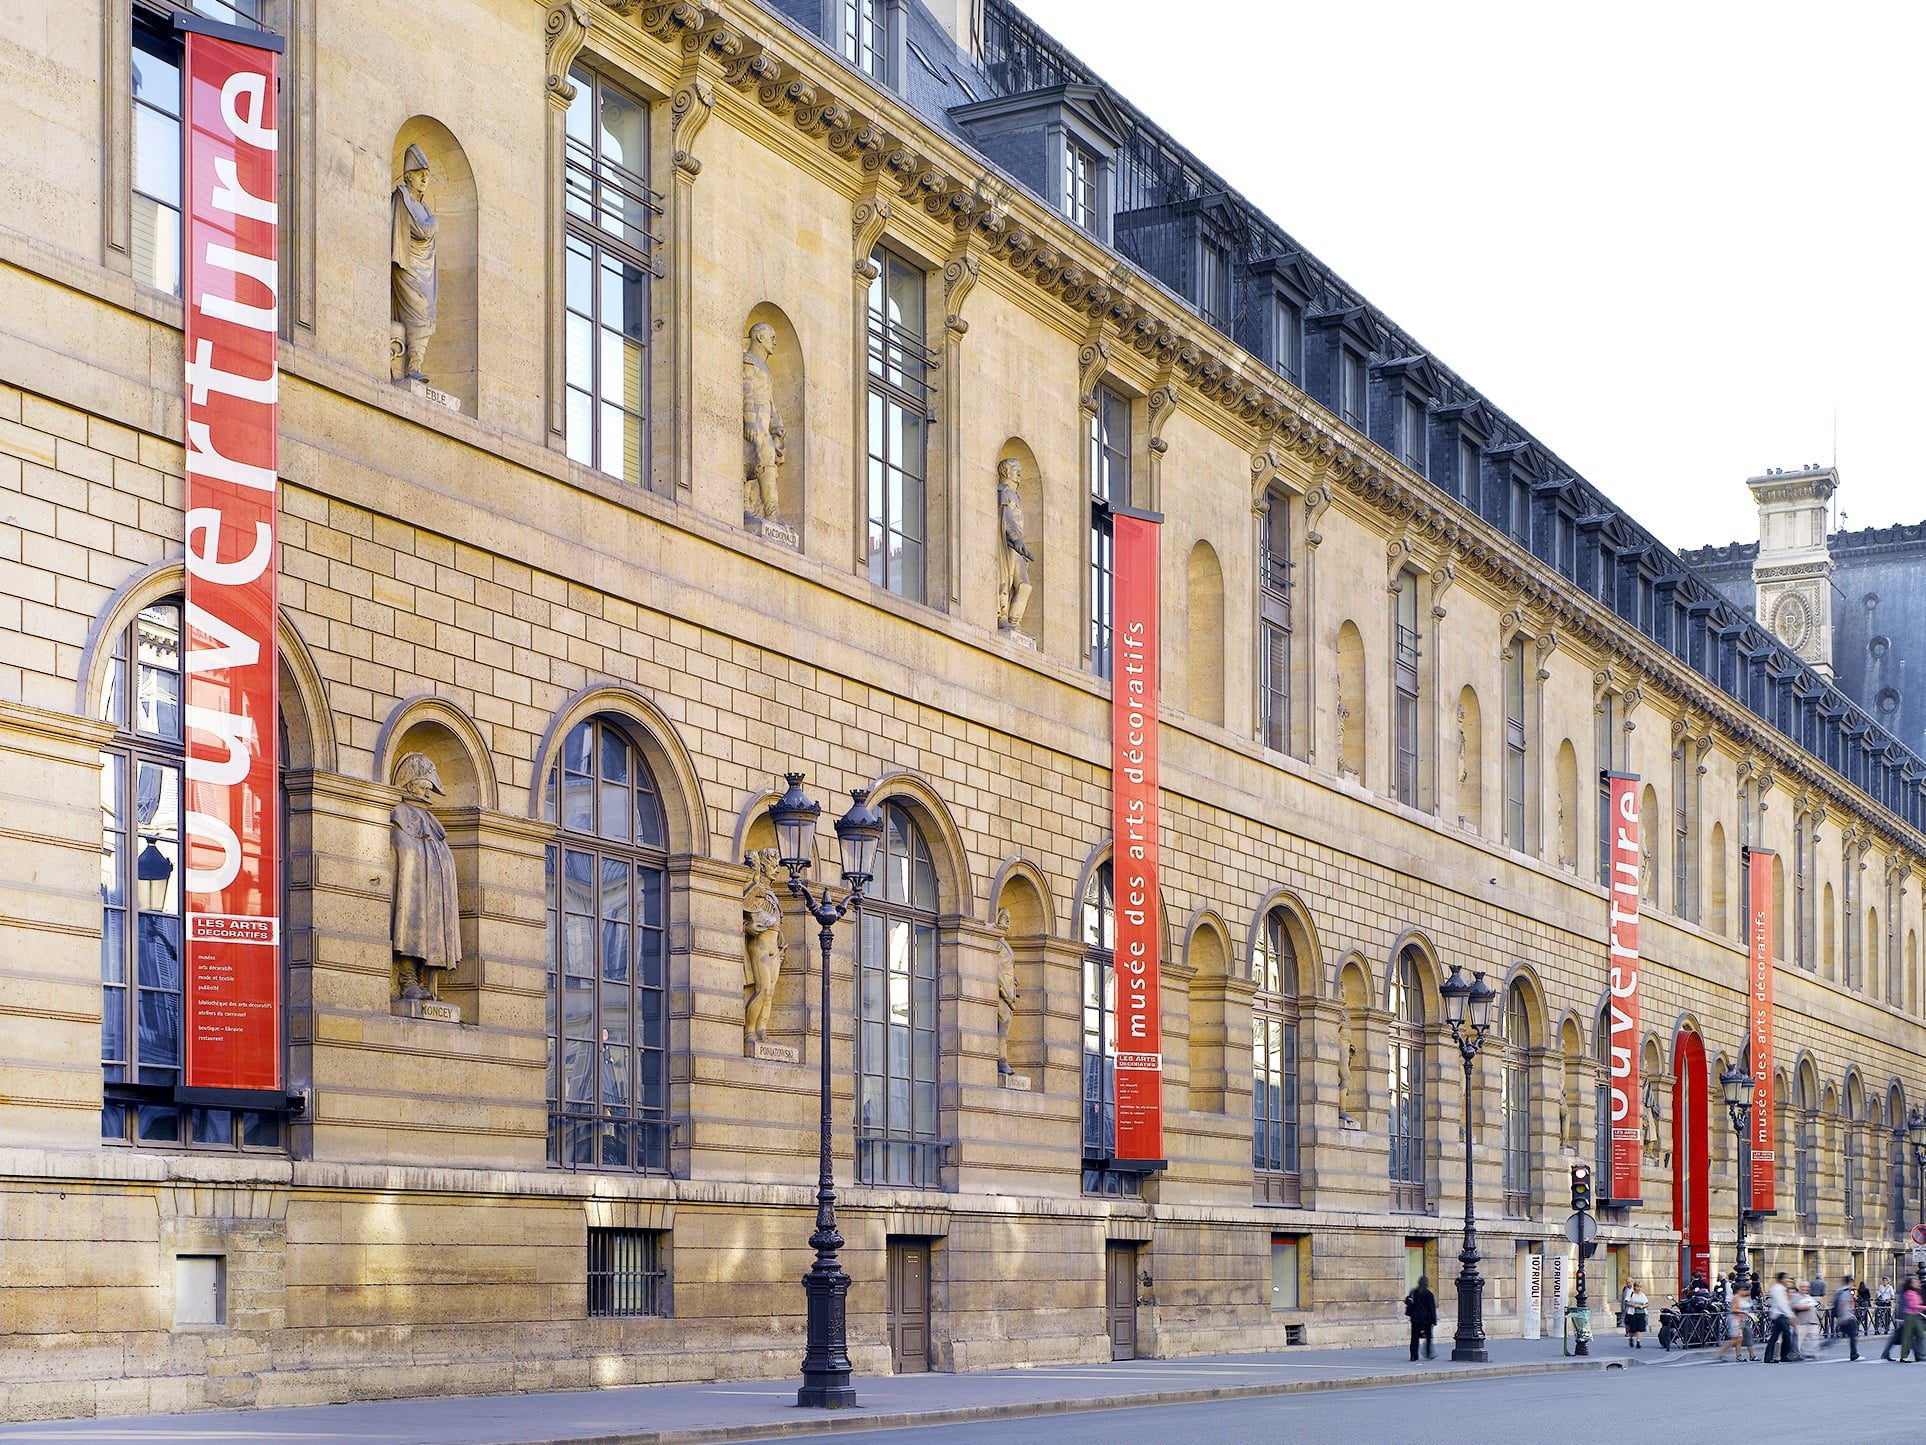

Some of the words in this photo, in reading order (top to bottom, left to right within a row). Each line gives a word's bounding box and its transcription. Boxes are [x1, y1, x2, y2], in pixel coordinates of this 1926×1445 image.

[185, 72, 278, 893] ouverture
[1123, 621, 1144, 784] décoratifs
[1125, 799, 1145, 860] arts
[197, 919, 225, 928] LES
[230, 921, 269, 931] ARTS
[1124, 876, 1145, 926] des
[197, 929, 268, 938] DECORATIFS
[1611, 791, 1639, 1122] ouverture
[1755, 911, 1767, 1002] décoratifs
[1124, 941, 1146, 1038] musée
[1756, 1010, 1767, 1044] arts
[1756, 1052, 1767, 1081] des
[1755, 1090, 1767, 1143] musée
